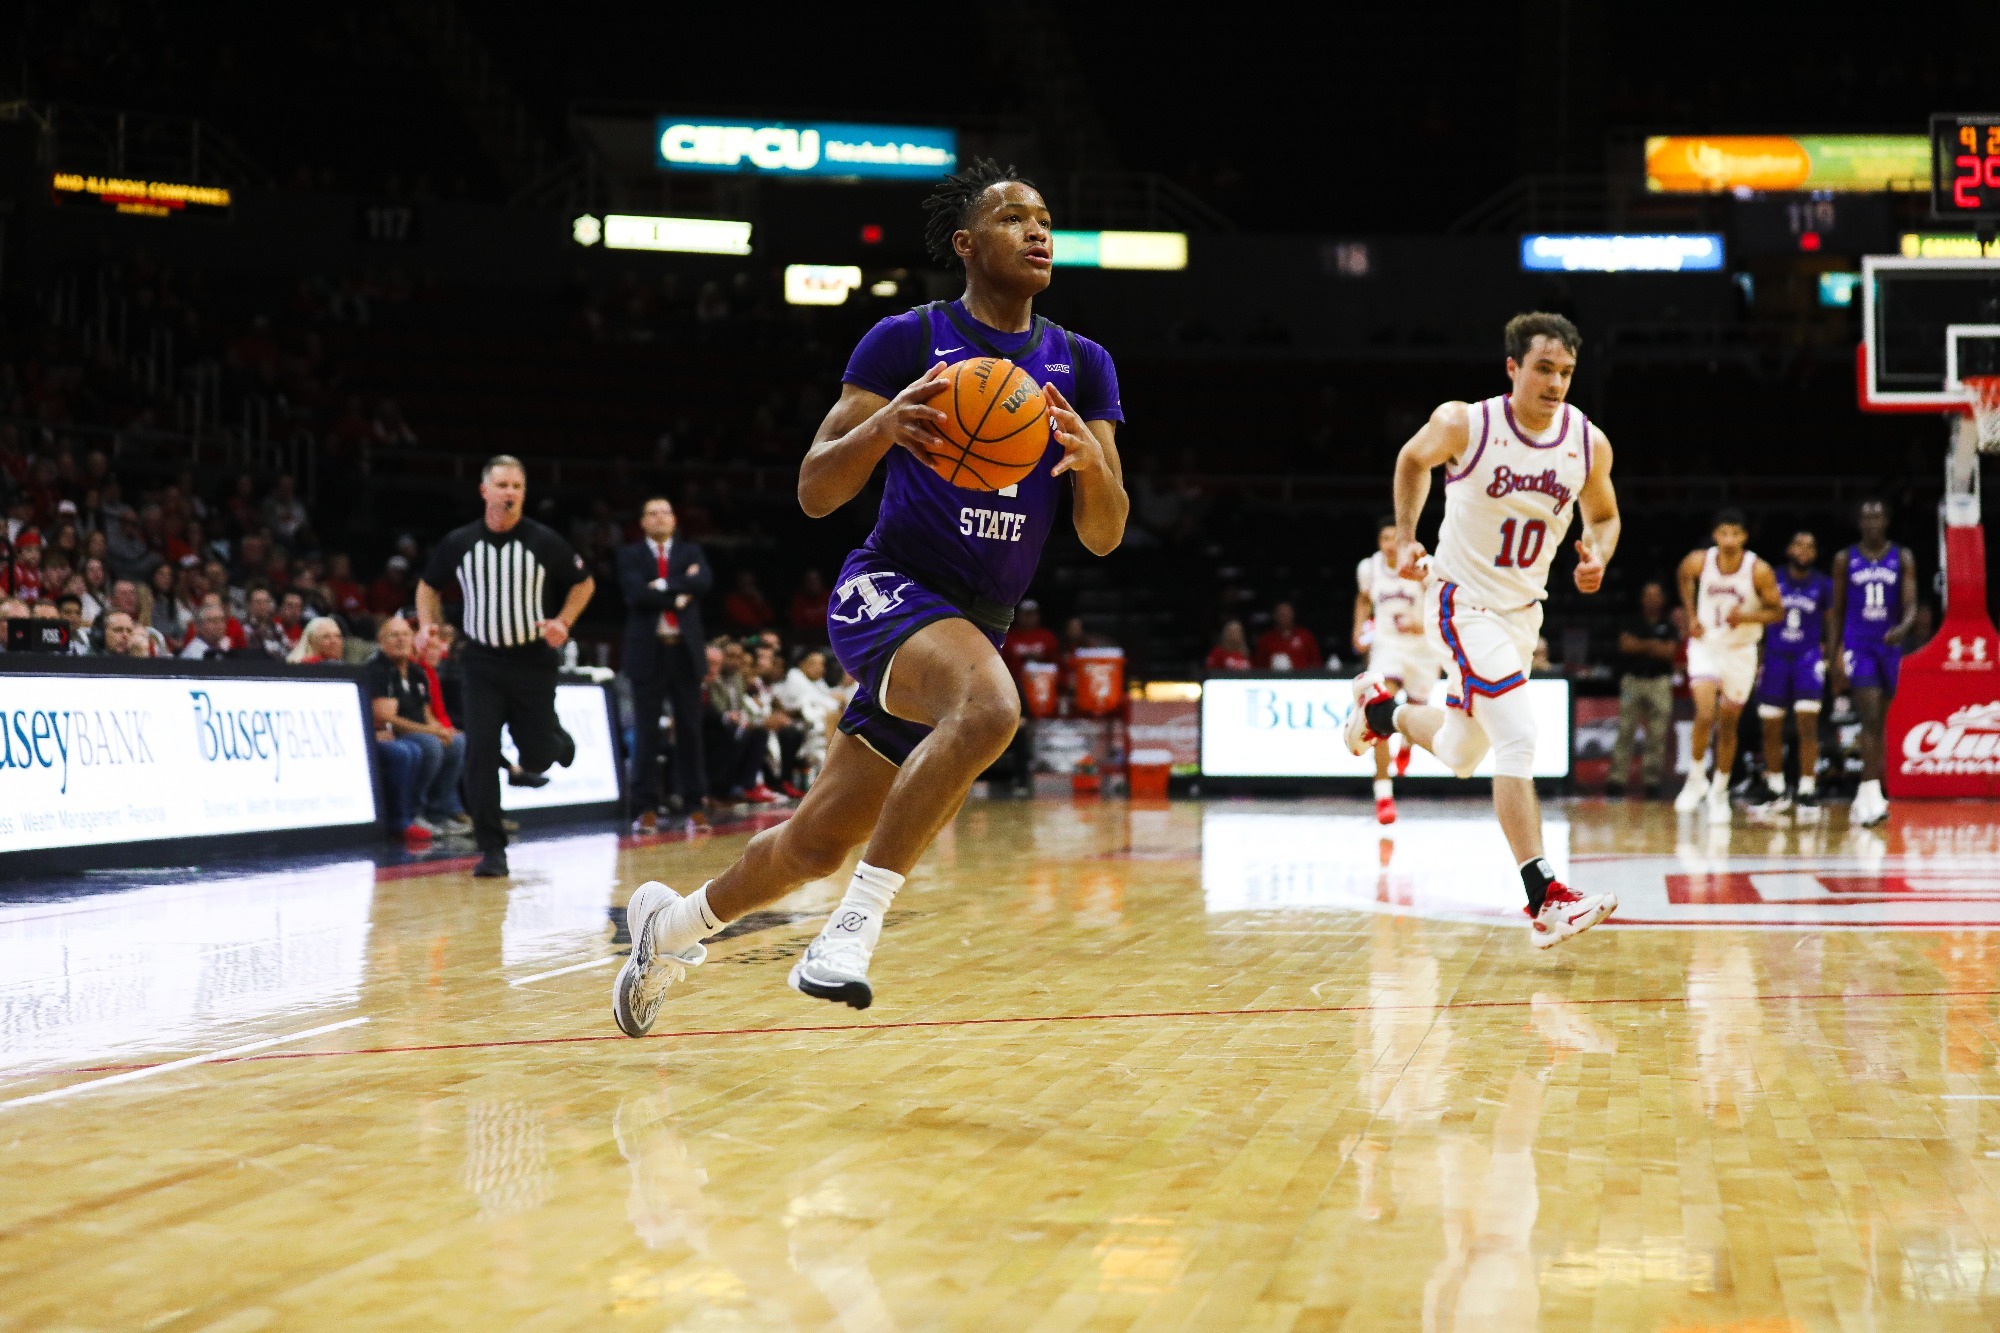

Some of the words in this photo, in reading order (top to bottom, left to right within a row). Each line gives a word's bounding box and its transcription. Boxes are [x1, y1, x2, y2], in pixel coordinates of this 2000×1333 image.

[660, 123, 820, 170] CEFCU
[367, 207, 411, 239] 117
[1044, 363, 1070, 374] WAC
[1486, 465, 1571, 516] Bradley
[960, 507, 1026, 542] STATE
[1494, 517, 1547, 569] 10
[1865, 582, 1884, 606] 11
[1246, 688, 1350, 730] Bus
[1902, 719, 2000, 760] Clu
[58, 808, 121, 832] Management
